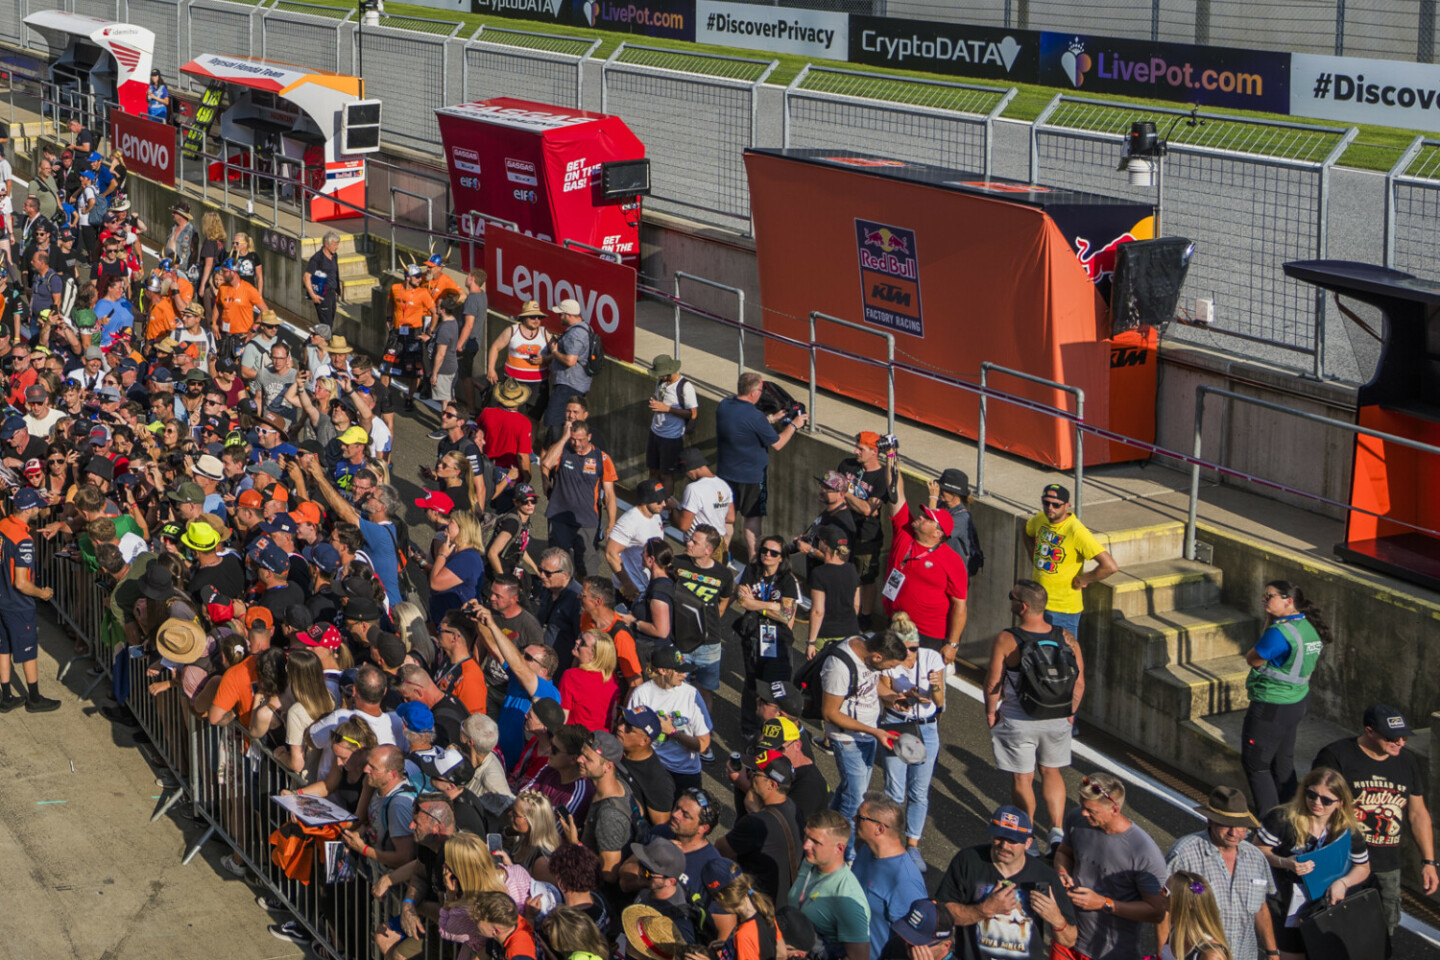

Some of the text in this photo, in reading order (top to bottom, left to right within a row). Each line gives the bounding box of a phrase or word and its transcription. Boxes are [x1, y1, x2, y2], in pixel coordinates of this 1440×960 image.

[602, 2, 684, 31] LivePot.com
[706, 12, 835, 49] #DiscoverPrivacy
[862, 30, 1002, 67] CryptoDATA
[208, 57, 286, 78] Repsol Honda Team
[1098, 51, 1264, 96] LivePot.com
[1313, 73, 1440, 111] #Discov
[114, 124, 169, 171] Lenovo
[454, 149, 478, 160] GASGAS
[506, 161, 535, 173] GASGAS
[564, 163, 602, 182] ON THE
[566, 158, 586, 172] GET
[460, 176, 473, 187] elf
[563, 178, 587, 192] GAS!
[513, 189, 528, 200] elf
[603, 235, 621, 245] GET
[616, 242, 633, 253] THE
[860, 248, 917, 279] Red Bull
[496, 247, 620, 333] Lenovo
[871, 282, 911, 307] KTM
[866, 308, 921, 332] FACTORY RACING
[163, 524, 180, 533] 46
[1353, 780, 1394, 789] MOTORRAD
[1397, 784, 1407, 792] GP
[1351, 790, 1408, 808] Austria
[1353, 809, 1364, 819] 21
